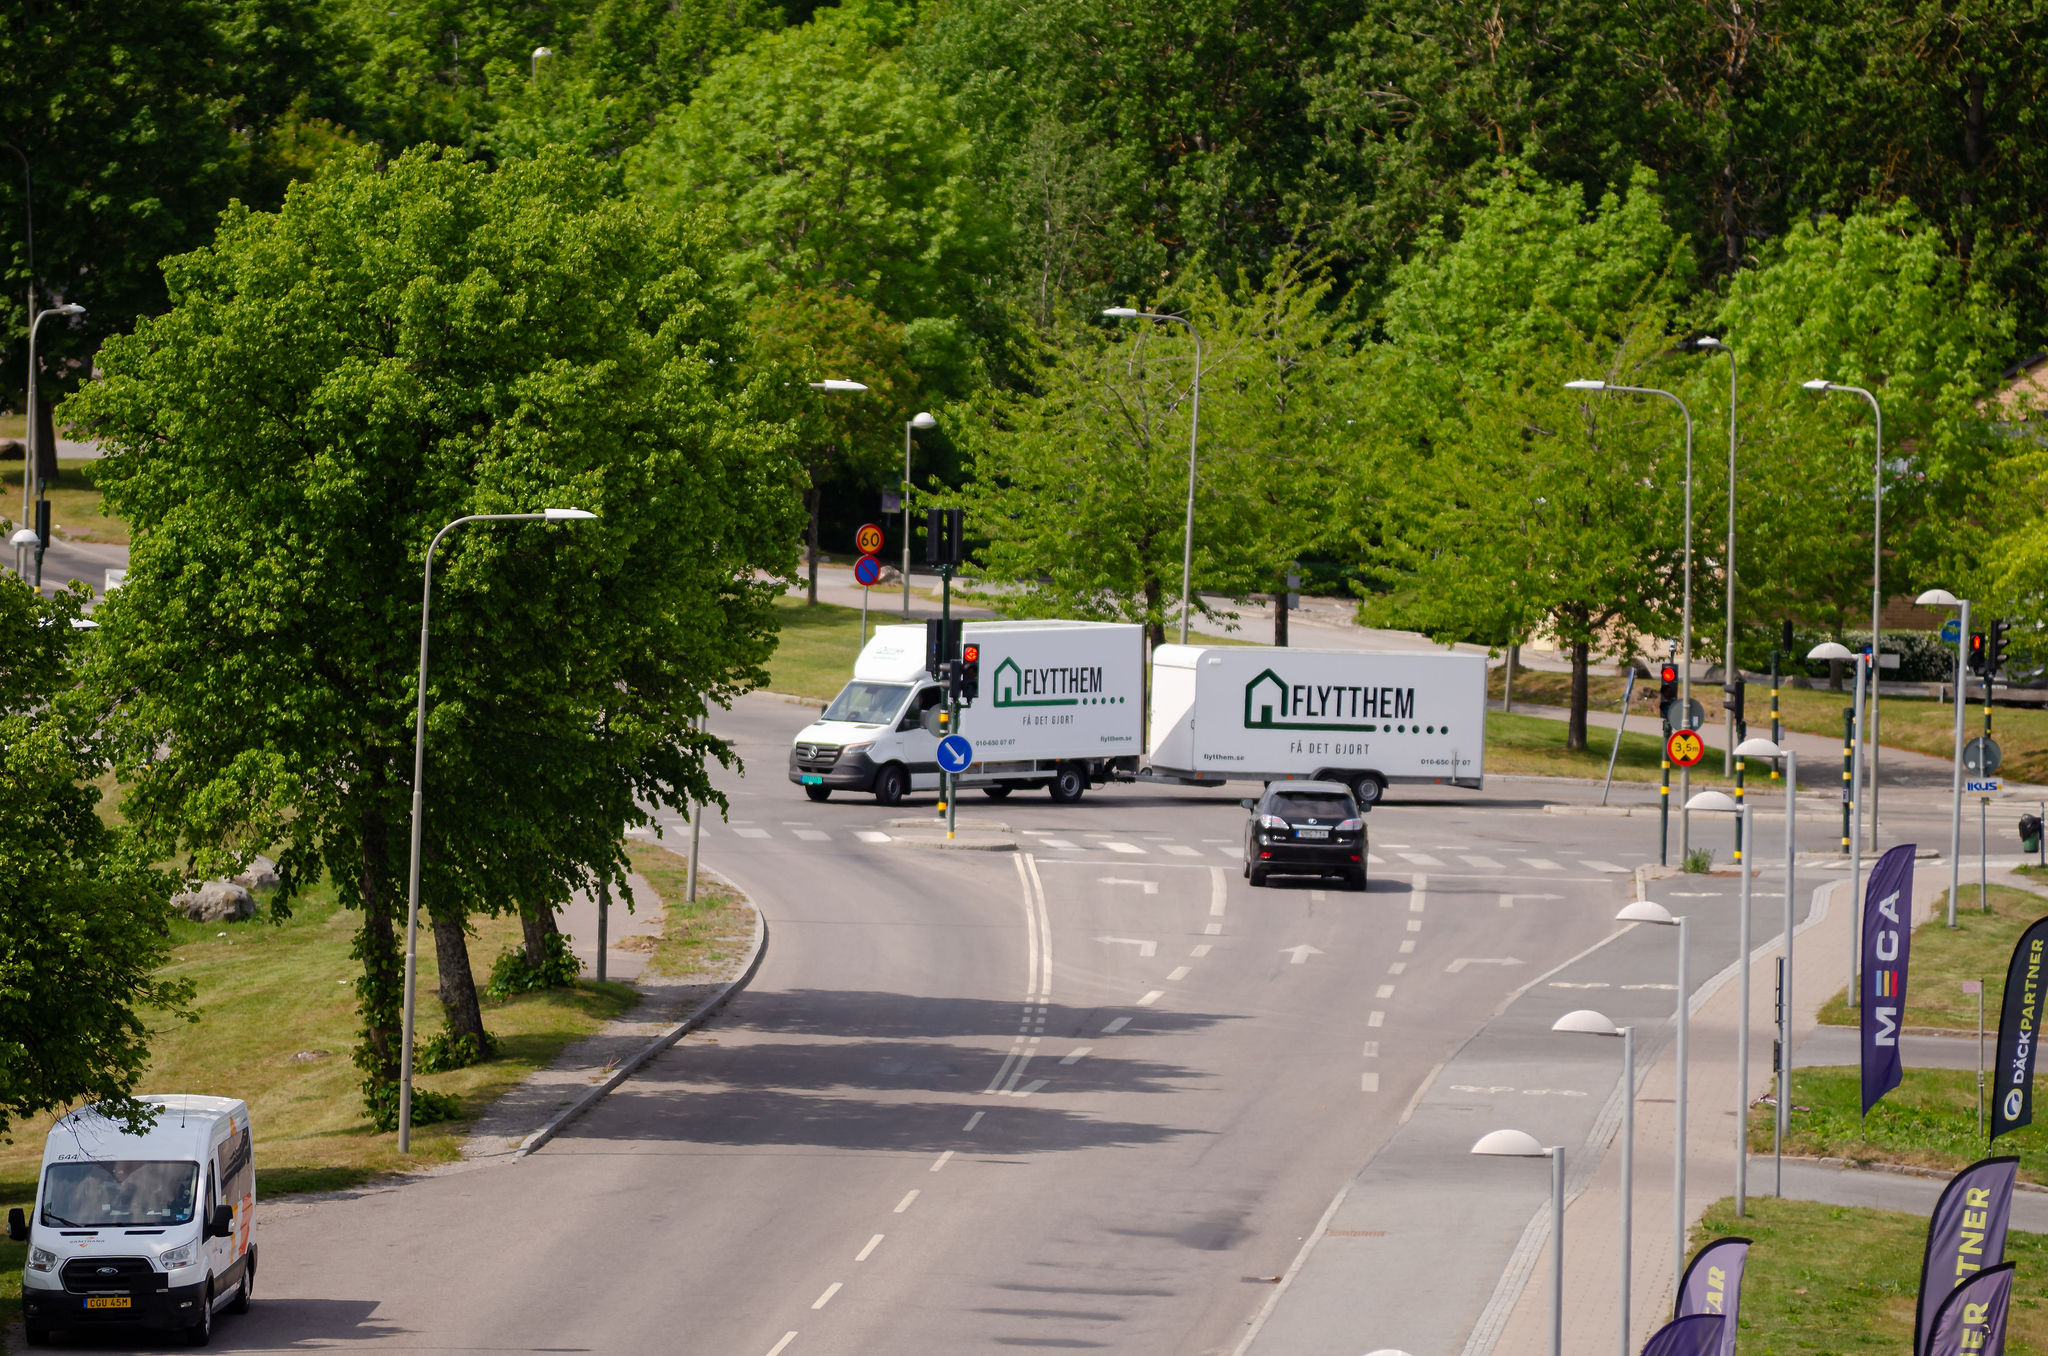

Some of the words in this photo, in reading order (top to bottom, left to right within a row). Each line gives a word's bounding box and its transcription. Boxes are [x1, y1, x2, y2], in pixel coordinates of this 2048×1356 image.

[861, 532, 880, 547] 60
[1024, 666, 1102, 695] FLYTTHEM
[1292, 685, 1414, 719] FLYTTHEM
[1022, 714, 1031, 726] FÅ
[1034, 715, 1048, 726] DET
[1051, 714, 1074, 725] GJORT
[1203, 753, 1245, 761] flytthem.se
[1290, 740, 1303, 753] FÅ
[1309, 743, 1329, 754] DET
[1335, 743, 1370, 755] GJORT
[1875, 890, 1900, 1046] MECA
[2012, 938, 2045, 1085] DÄCKPARTNER
[90, 1298, 107, 1307] CGU
[111, 1298, 128, 1307] 45M
[1960, 1302, 1989, 1356] ER
